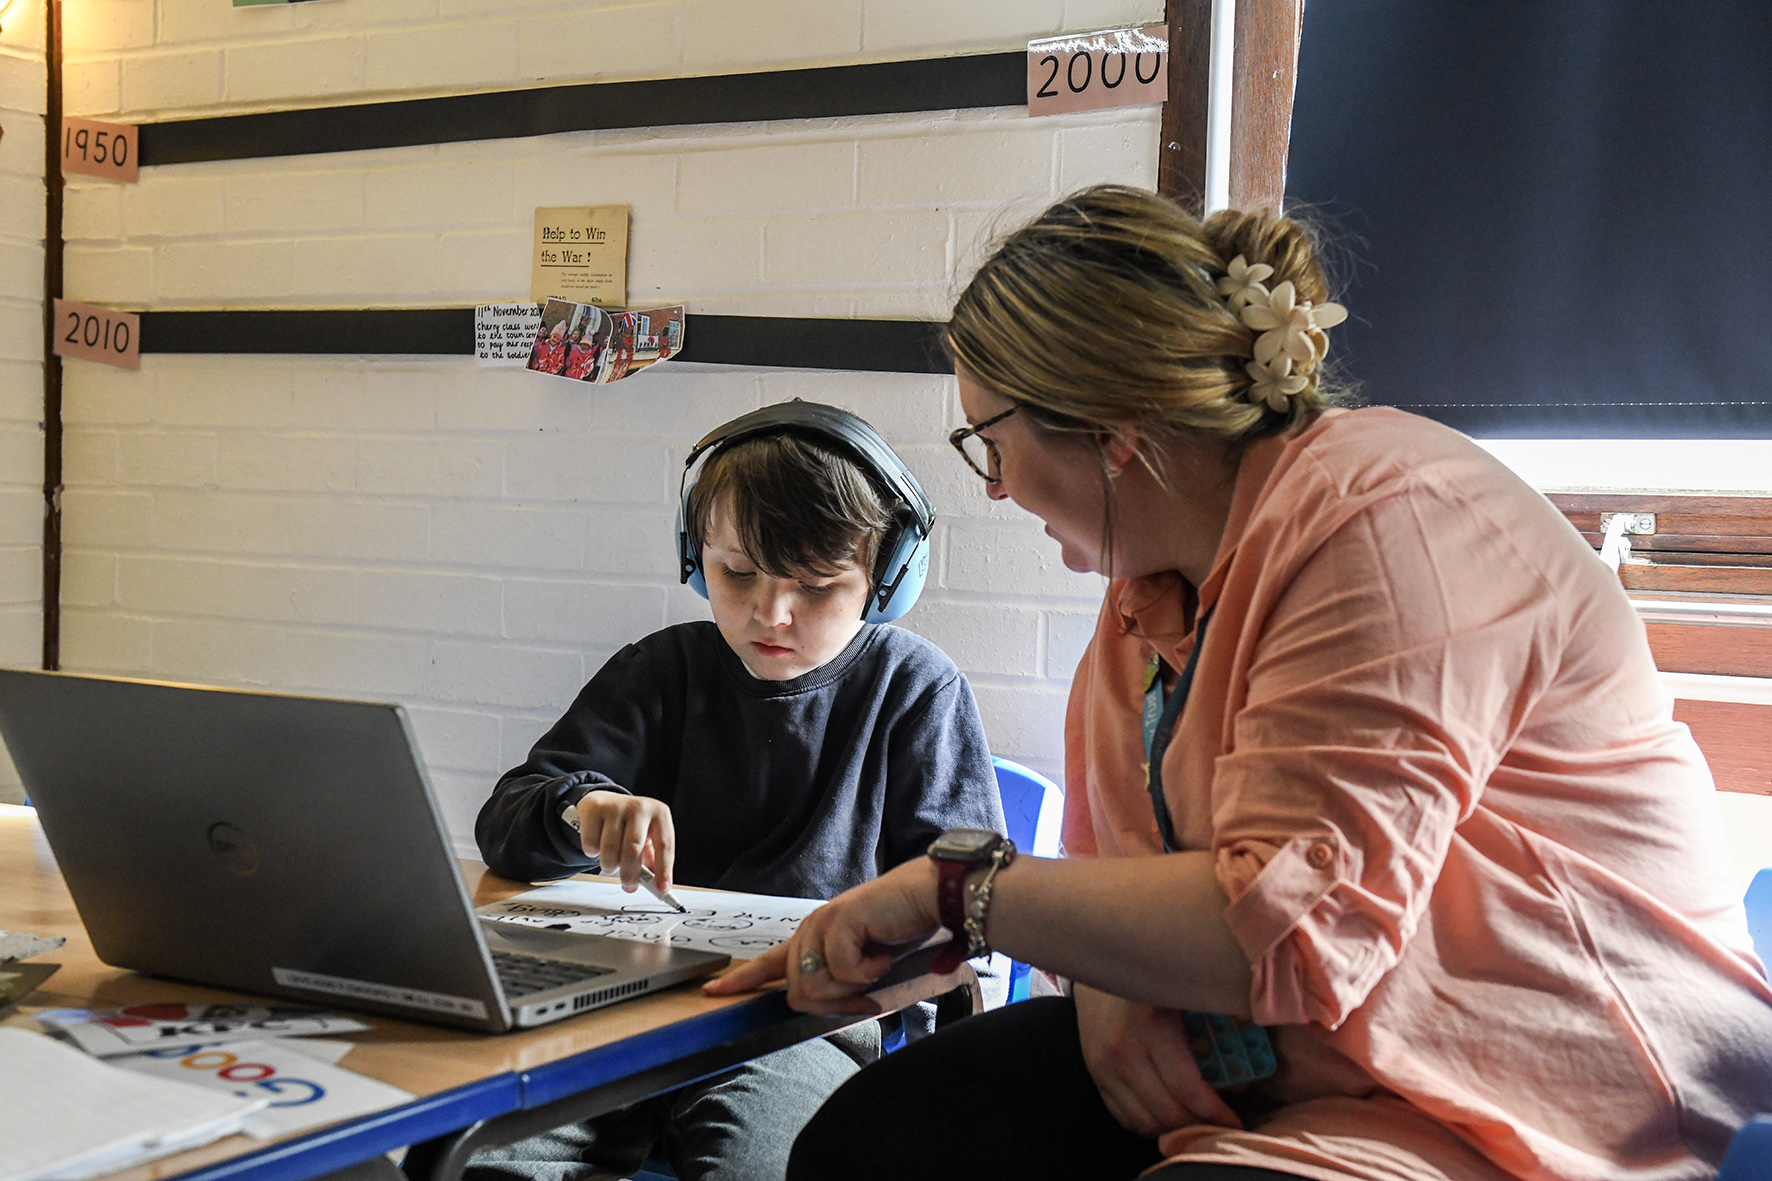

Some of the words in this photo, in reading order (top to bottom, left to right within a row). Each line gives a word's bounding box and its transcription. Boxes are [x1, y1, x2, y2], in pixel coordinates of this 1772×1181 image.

[1036, 46, 1161, 98] 2000
[65, 127, 128, 167] 1950
[542, 226, 566, 242] Help
[570, 228, 581, 240] to
[586, 226, 606, 240] Win
[541, 249, 557, 263] the
[562, 250, 582, 263] War
[493, 305, 529, 317] November
[65, 312, 130, 354] 2010
[477, 321, 500, 334] Cherry
[502, 322, 521, 331] class
[477, 332, 486, 340] to
[489, 331, 503, 340] the
[477, 341, 486, 349] to
[489, 341, 504, 352] pay
[479, 351, 489, 359] to
[491, 350, 504, 359] the
